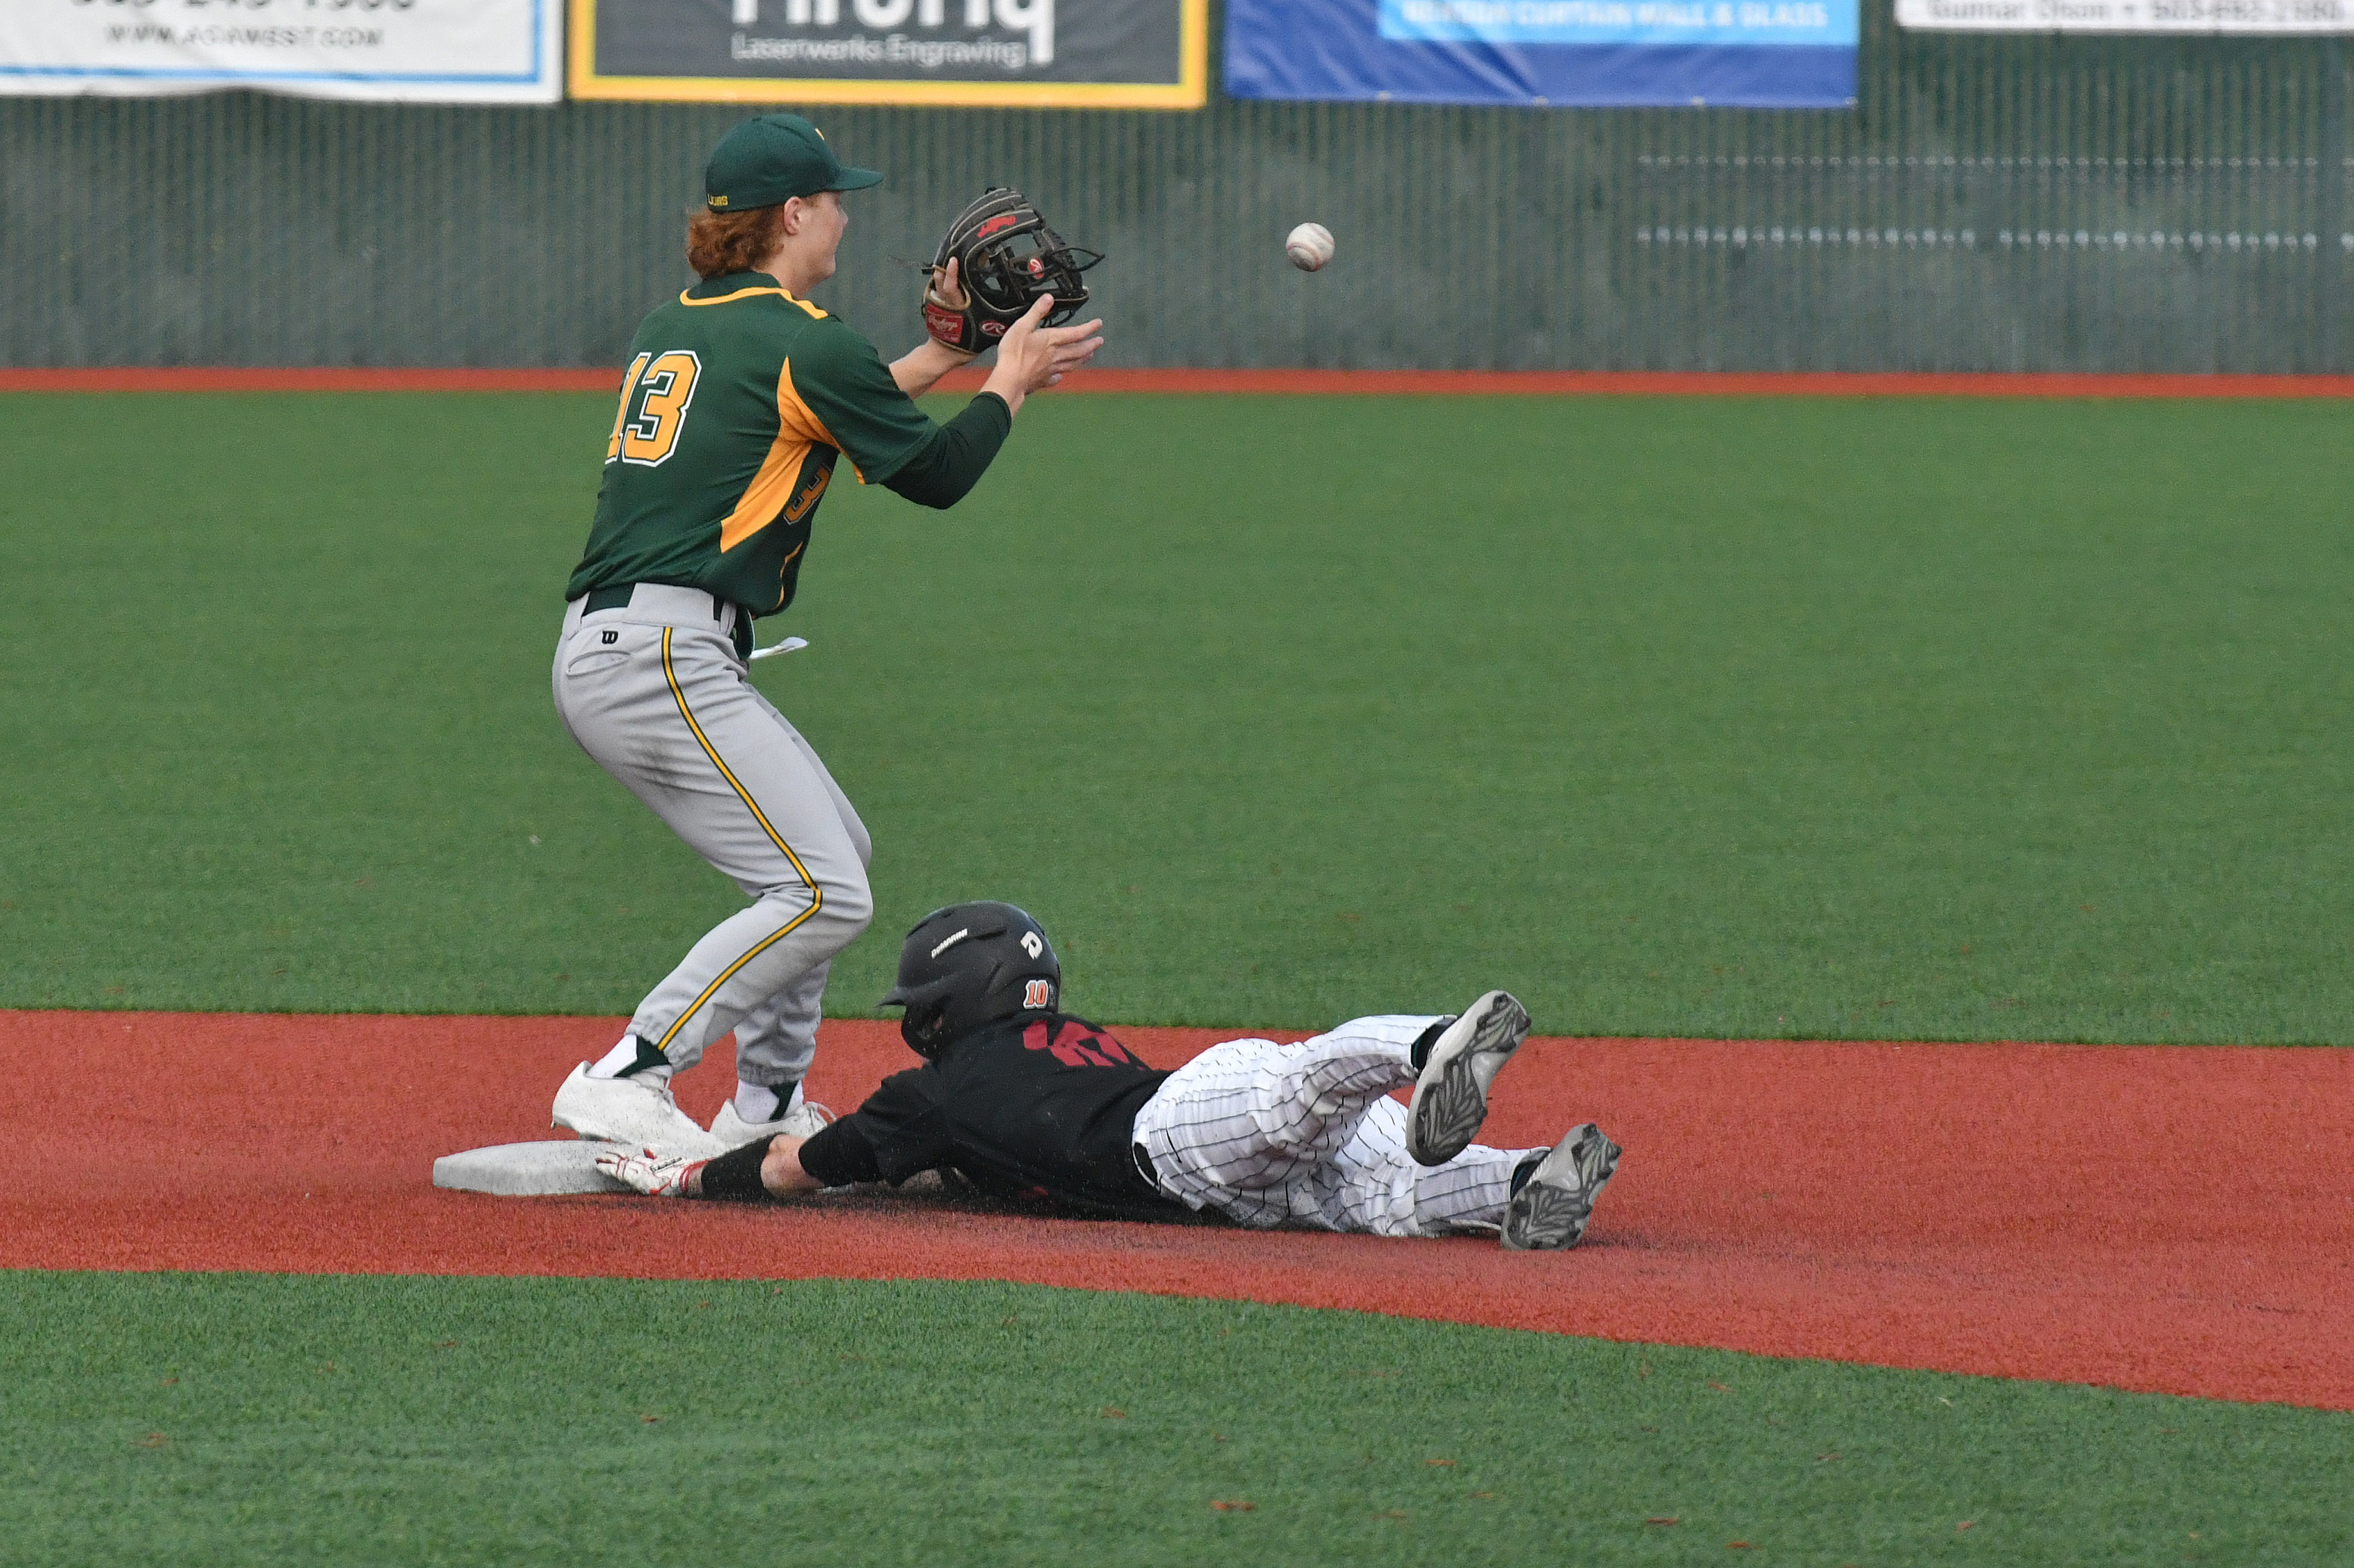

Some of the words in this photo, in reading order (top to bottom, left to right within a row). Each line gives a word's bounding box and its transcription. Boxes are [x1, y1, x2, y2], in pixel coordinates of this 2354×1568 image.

[731, 32, 882, 61] Laserworks
[886, 33, 1026, 68] Engraving
[605, 350, 701, 467] 13
[1023, 979, 1049, 1010] 10
